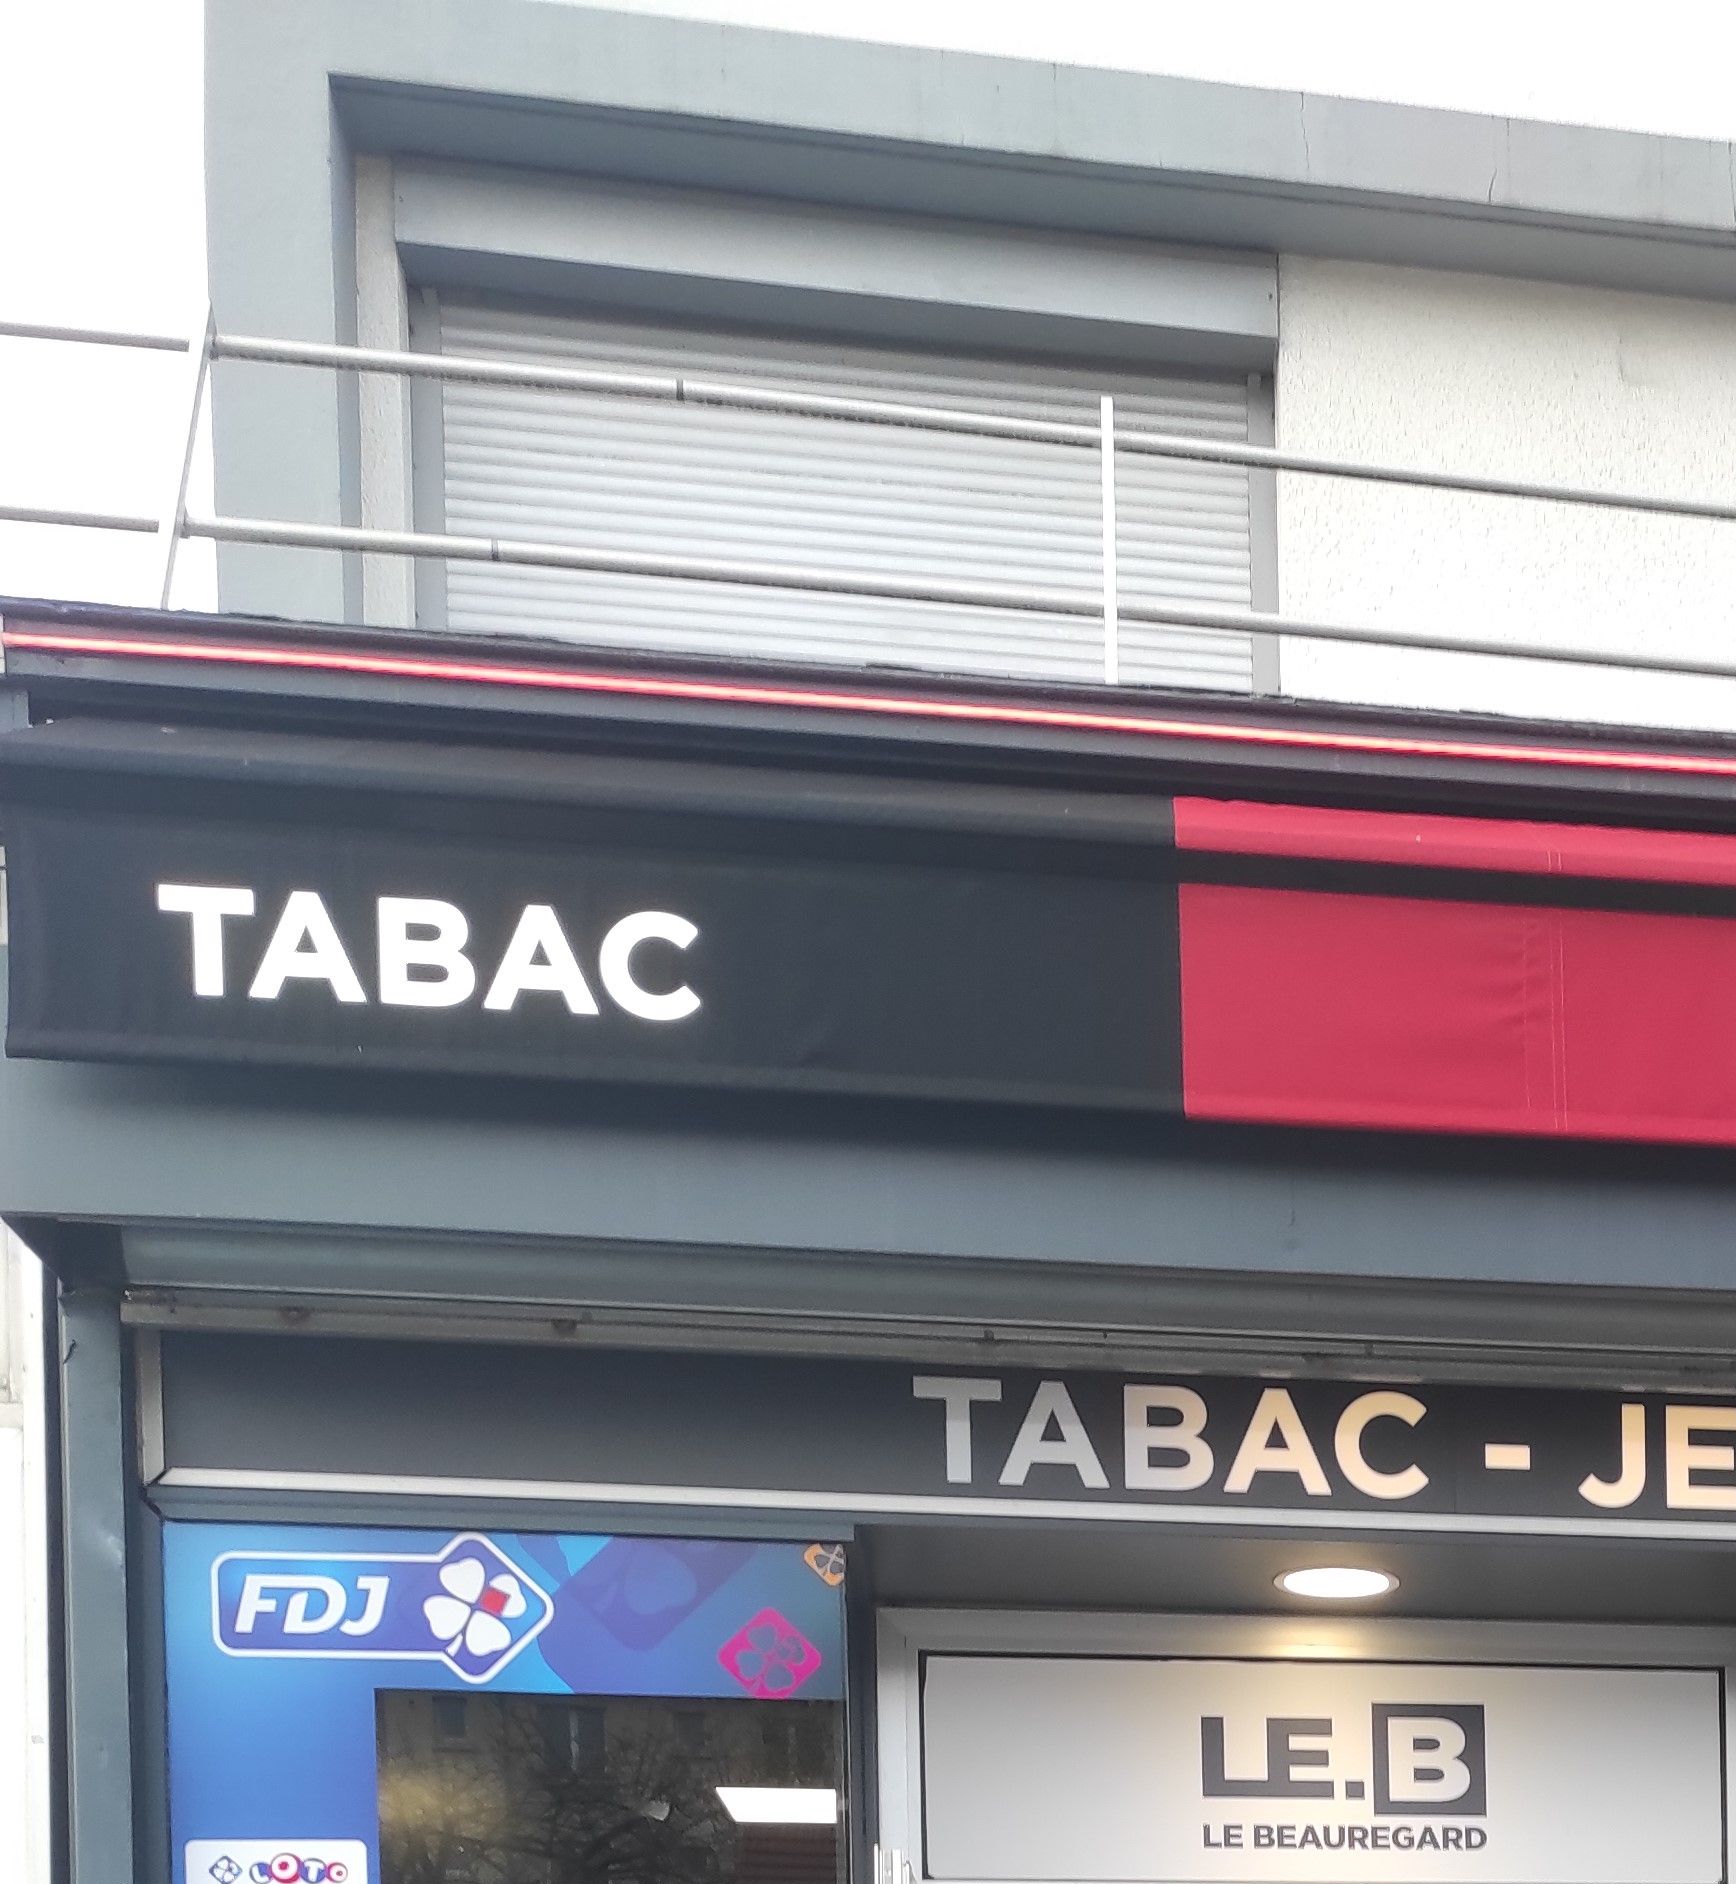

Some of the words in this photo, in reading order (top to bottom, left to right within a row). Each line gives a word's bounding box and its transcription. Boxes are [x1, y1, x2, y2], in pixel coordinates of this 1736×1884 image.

[156, 883, 702, 1021] TABAC
[912, 1375, 1430, 1500] TABAC
[235, 1574, 390, 1637] FDJ
[1201, 1703, 1486, 1816] LE.B
[249, 1853, 348, 1884] LOTO
[1203, 1824, 1243, 1848] LE
[1254, 1824, 1487, 1851] BEAUREGARD
